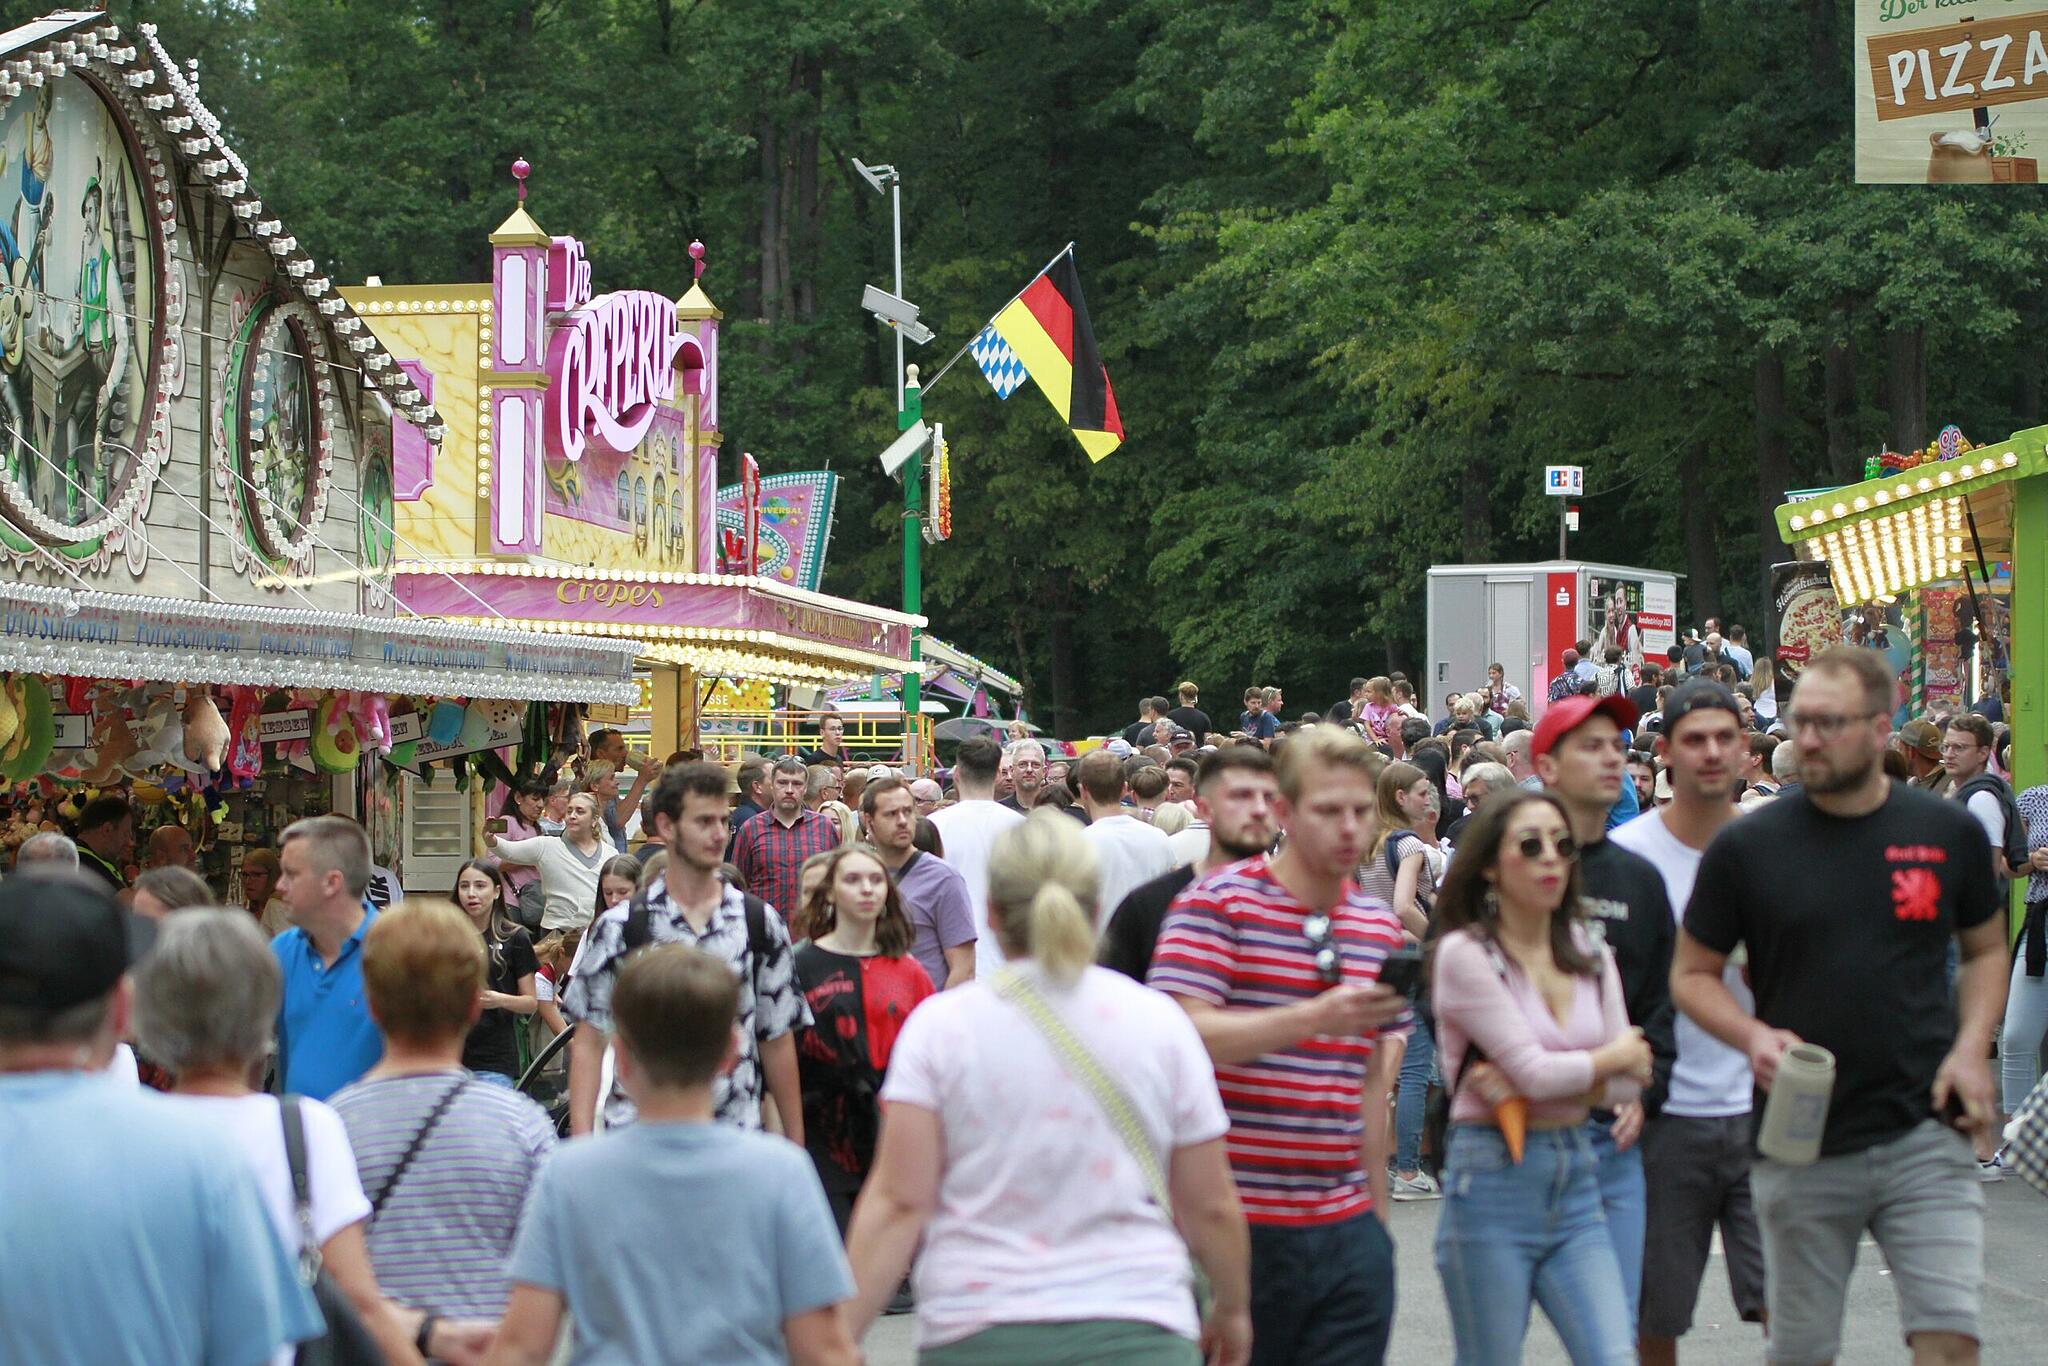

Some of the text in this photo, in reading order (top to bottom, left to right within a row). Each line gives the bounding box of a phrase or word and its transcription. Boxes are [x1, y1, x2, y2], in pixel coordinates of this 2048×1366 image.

[1880, 0, 1928, 22] Der
[1888, 30, 2048, 105] PIZZA
[557, 580, 664, 608] Crepes
